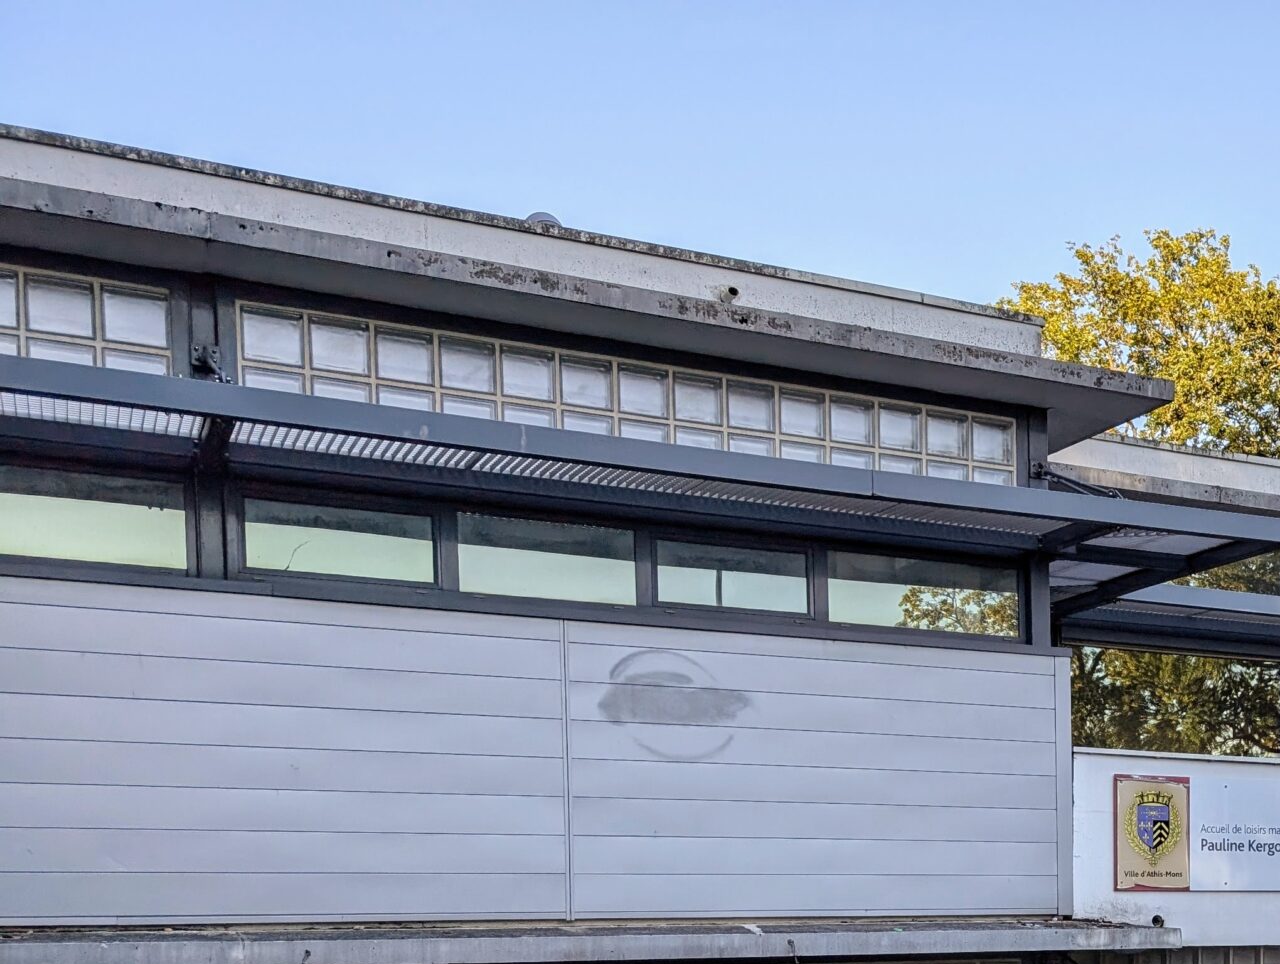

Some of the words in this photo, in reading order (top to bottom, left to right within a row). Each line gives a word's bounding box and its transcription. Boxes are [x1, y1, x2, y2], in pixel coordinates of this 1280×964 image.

[1200, 823, 1230, 834] Accueil
[1232, 824, 1242, 834] de
[1244, 824, 1267, 835] loisirs
[1200, 838, 1245, 852] Pauline
[1124, 870, 1140, 878] Ville
[1140, 870, 1183, 878] d'Athis-Mons
